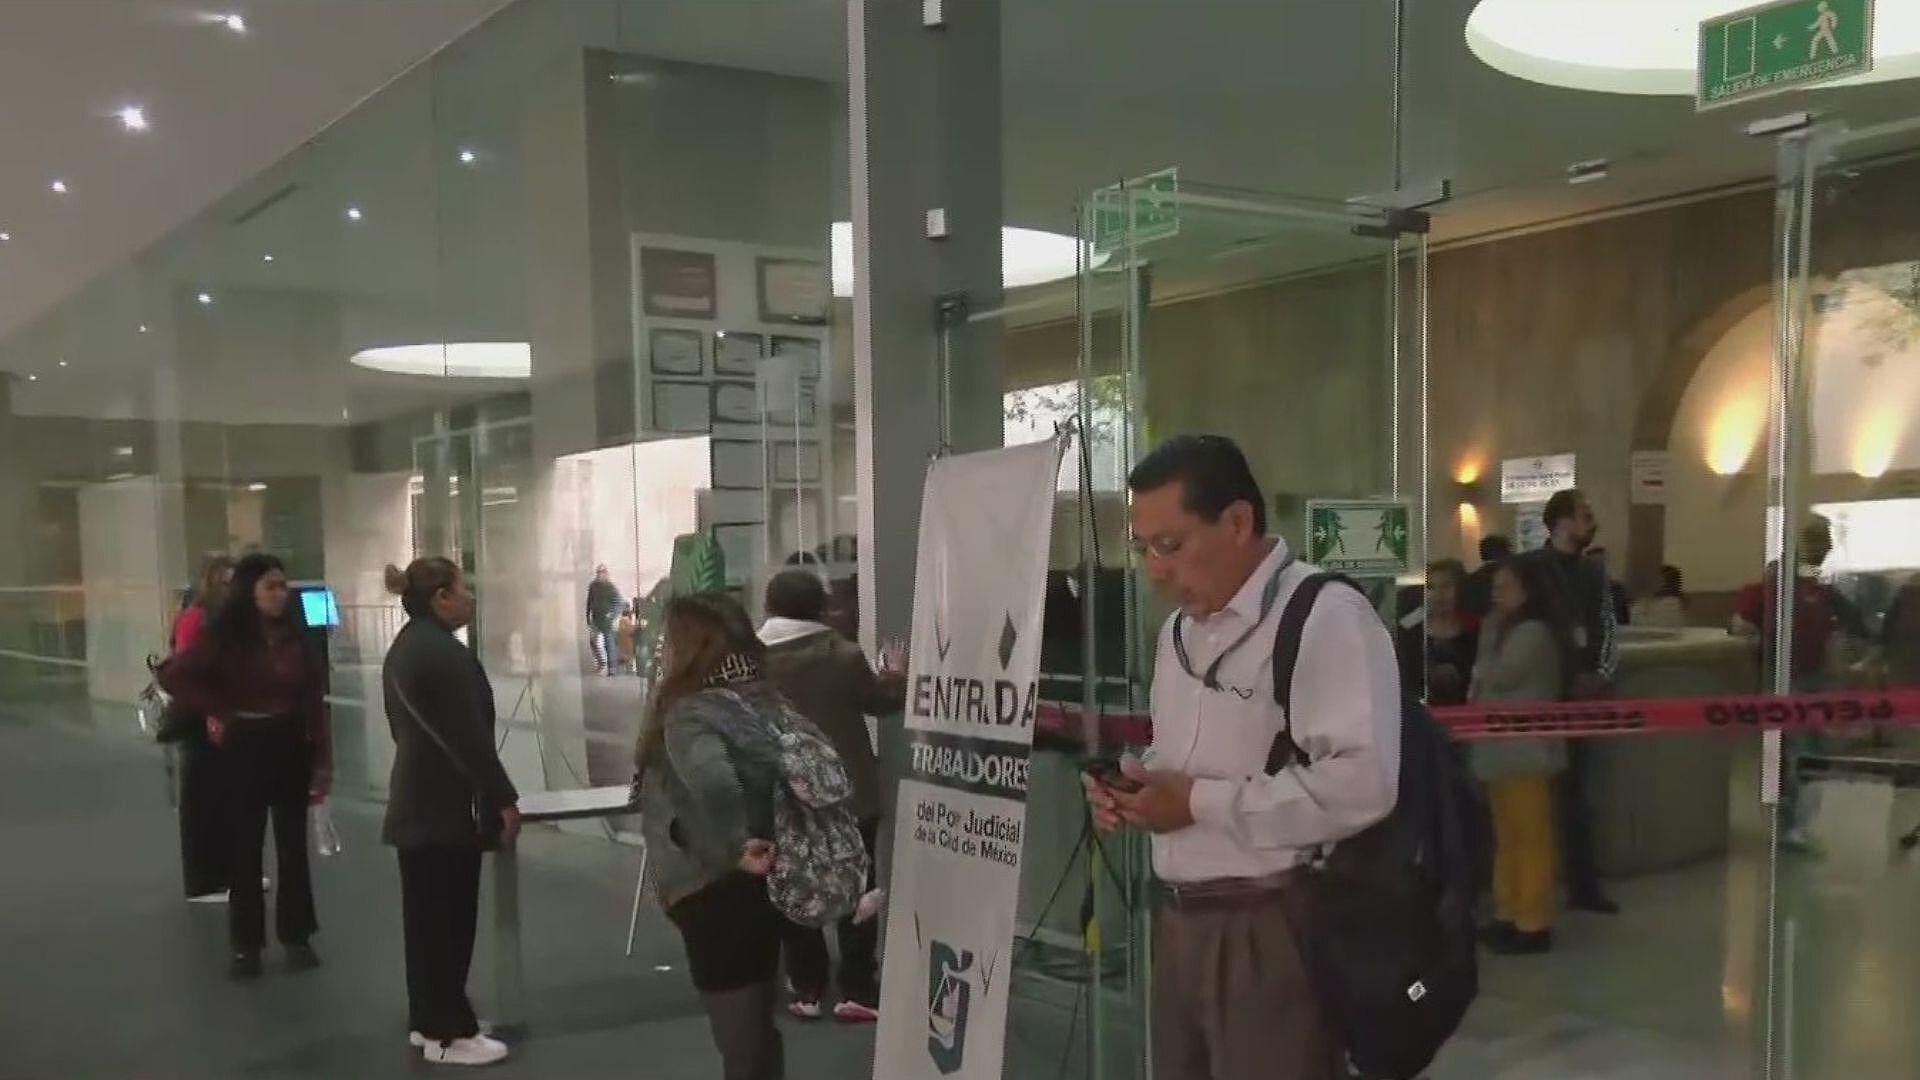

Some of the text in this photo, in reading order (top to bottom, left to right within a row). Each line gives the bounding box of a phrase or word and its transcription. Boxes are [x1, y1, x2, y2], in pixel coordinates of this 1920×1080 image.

[1703, 699, 1894, 727] PELIGRO
[916, 800, 935, 822] del
[964, 808, 1022, 844] Judicial
[962, 838, 976, 856] de
